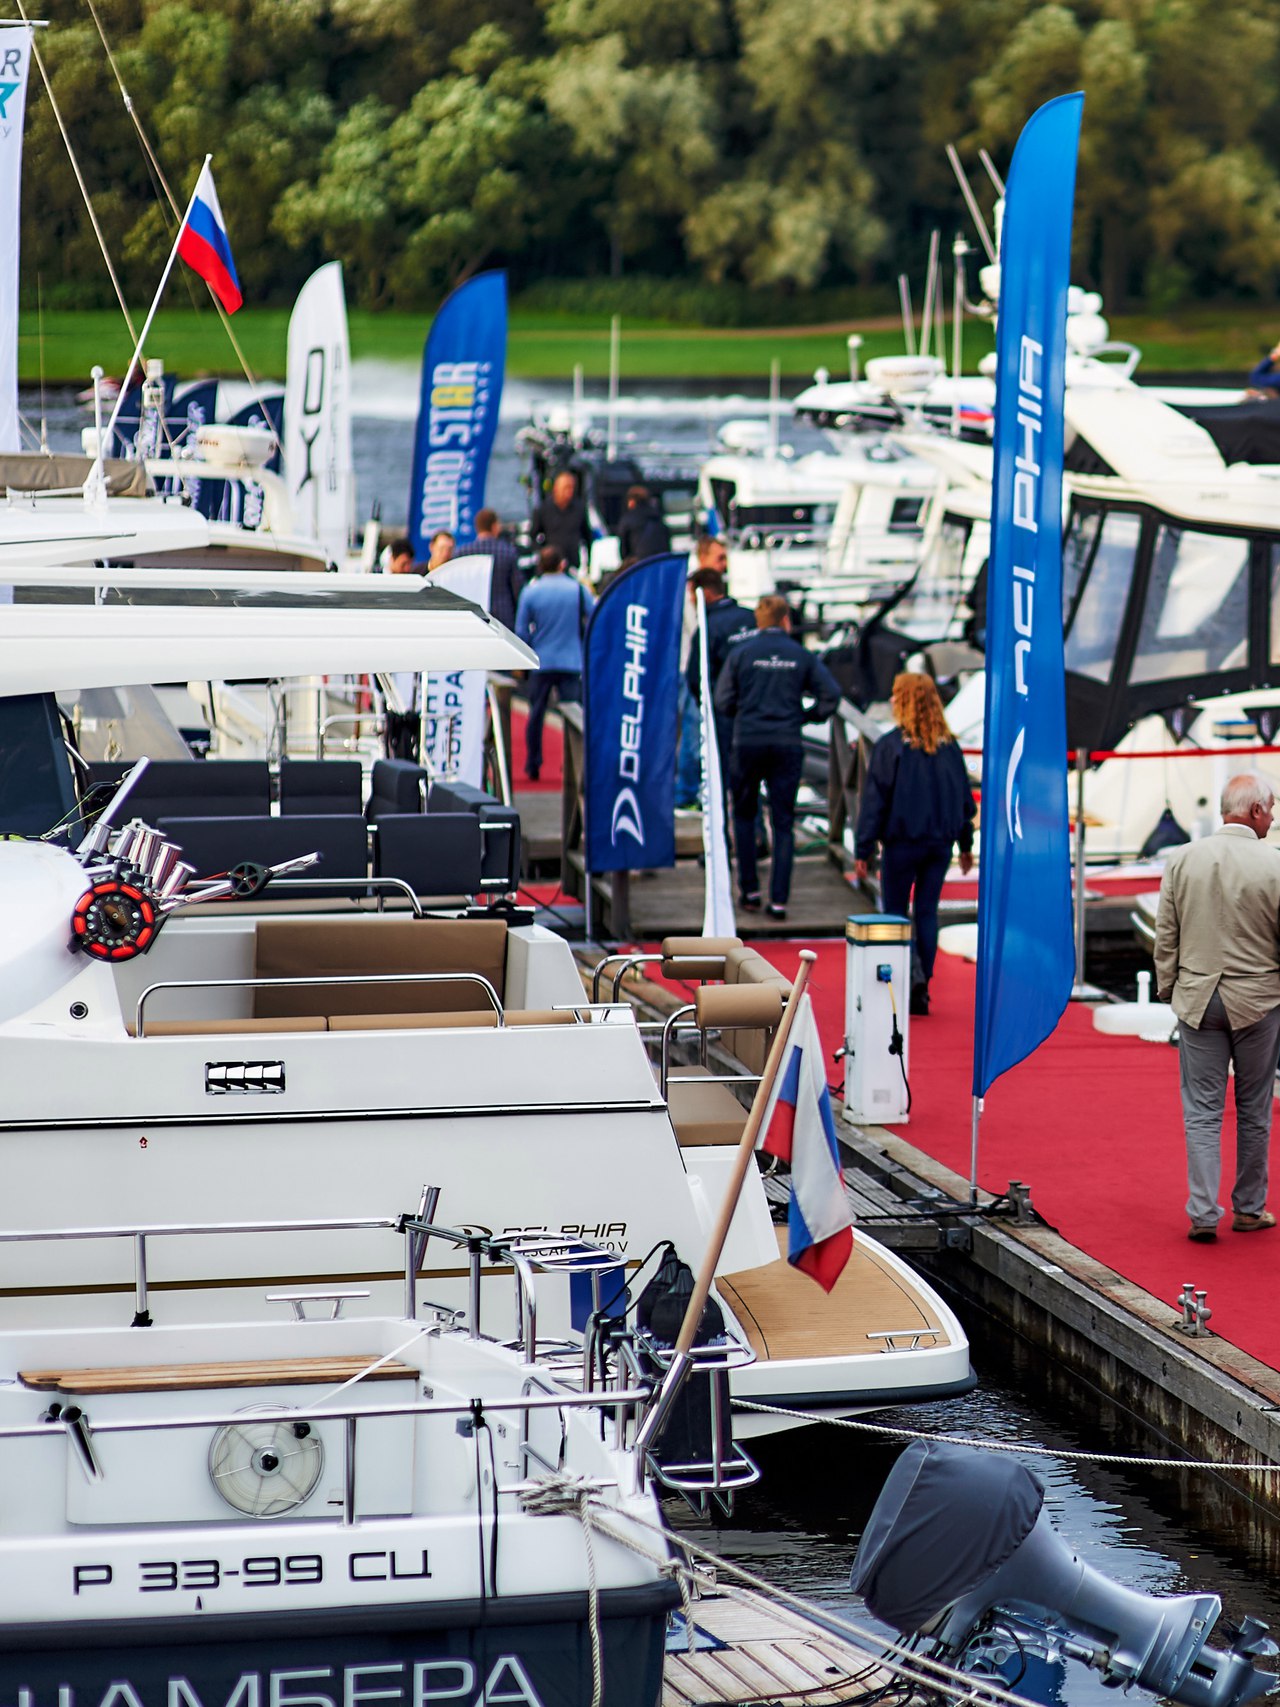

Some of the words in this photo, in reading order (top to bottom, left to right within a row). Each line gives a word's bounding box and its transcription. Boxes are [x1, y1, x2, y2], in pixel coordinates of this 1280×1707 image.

[428, 362, 480, 446] STAR
[619, 604, 649, 783] DELPHIA
[138, 1554, 323, 1593] 33-99
